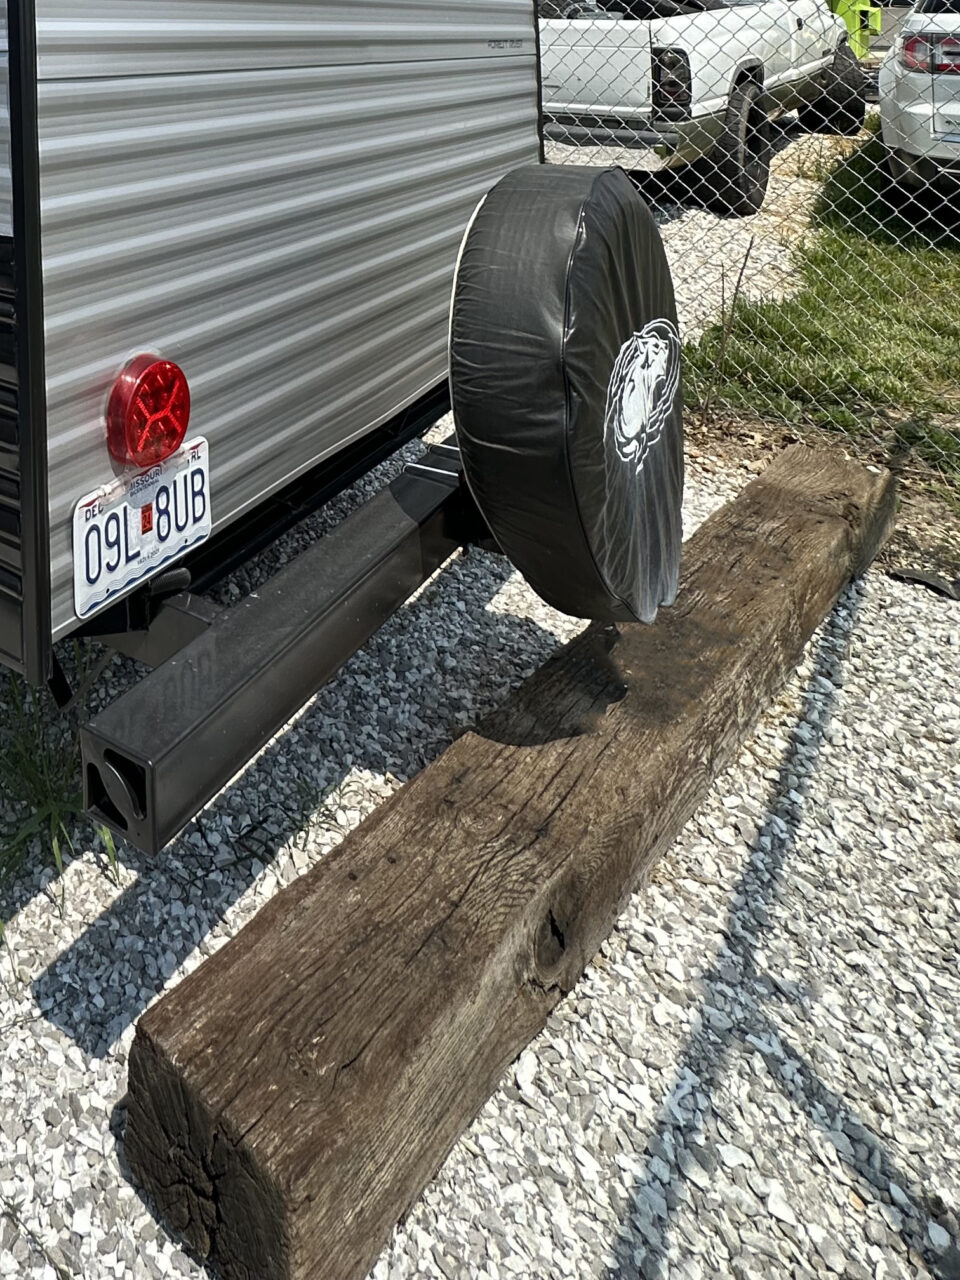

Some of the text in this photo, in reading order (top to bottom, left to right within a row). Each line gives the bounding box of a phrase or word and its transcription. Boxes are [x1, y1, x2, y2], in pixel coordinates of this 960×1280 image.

[187, 449, 201, 464] RL
[85, 467, 207, 585] 09L 8UB
